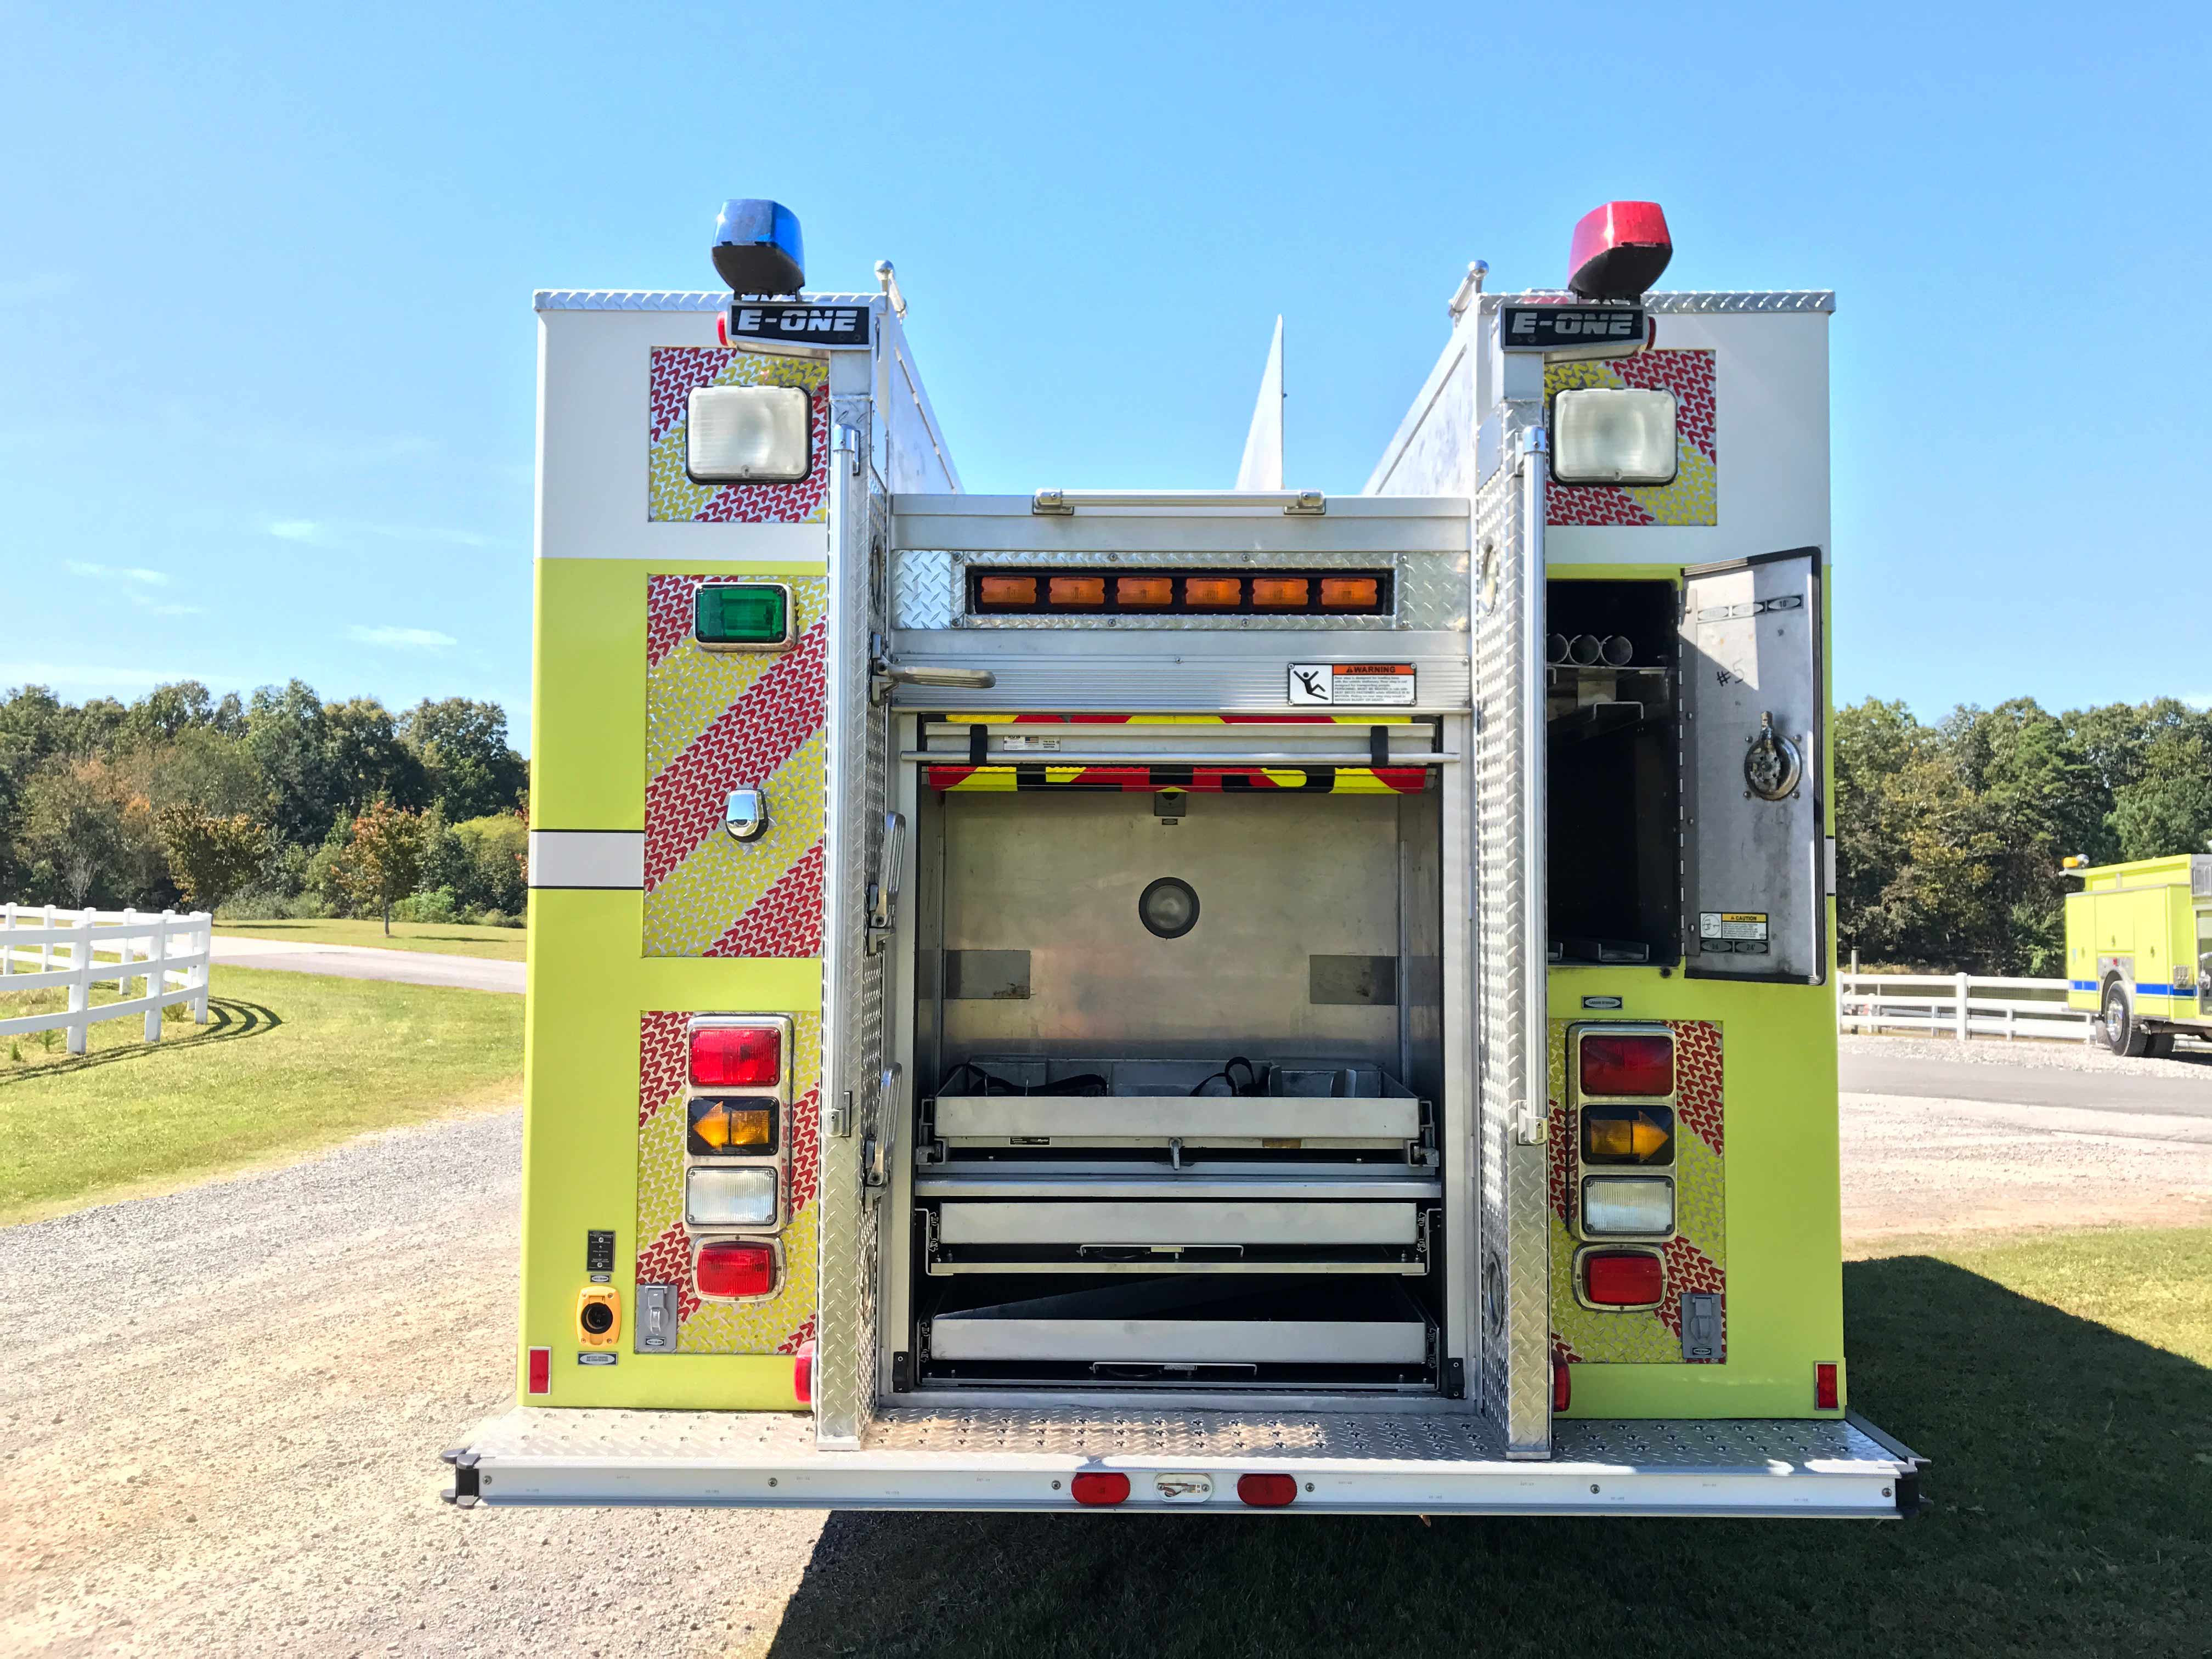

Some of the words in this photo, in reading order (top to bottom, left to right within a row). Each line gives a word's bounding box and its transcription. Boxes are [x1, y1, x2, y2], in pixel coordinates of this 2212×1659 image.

[737, 309, 858, 331] E-ONE
[1512, 312, 1634, 335] E-ONE
[1716, 658, 1745, 687] #5
